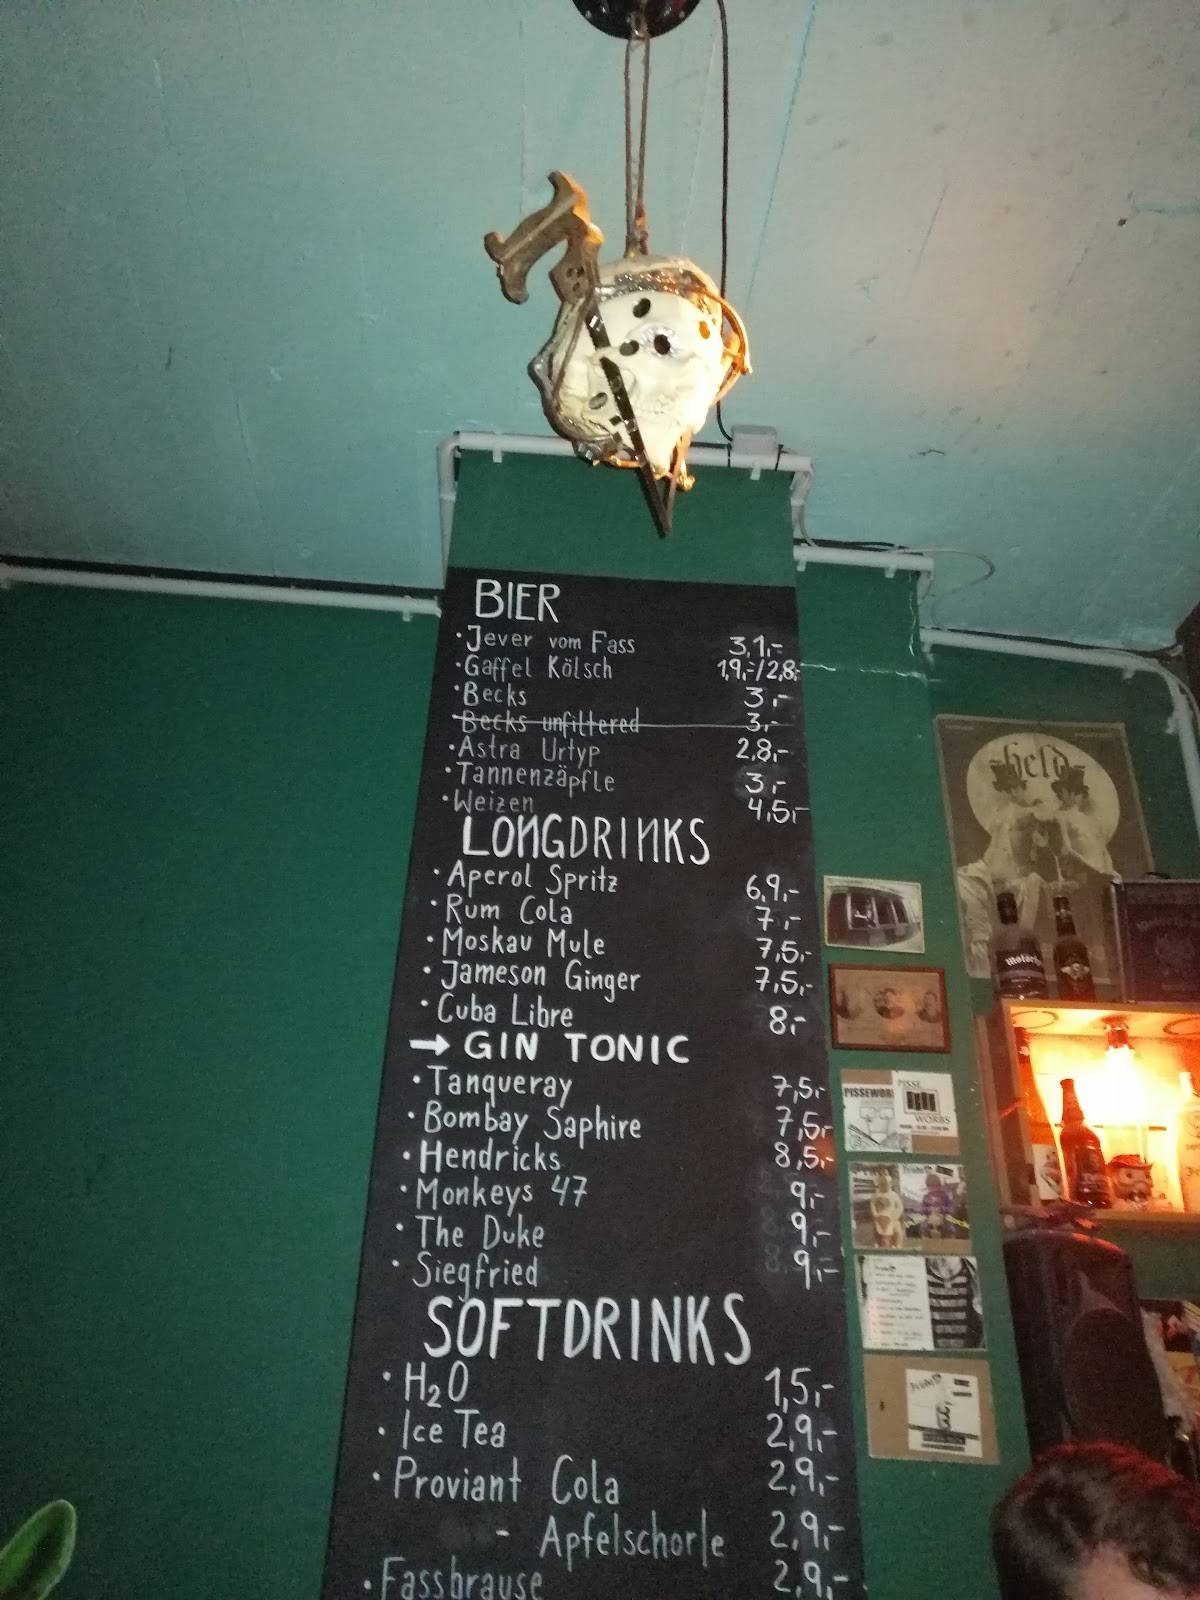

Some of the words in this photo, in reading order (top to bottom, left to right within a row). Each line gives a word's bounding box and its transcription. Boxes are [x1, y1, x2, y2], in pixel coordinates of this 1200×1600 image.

[475, 578, 560, 623] BIER
[465, 625, 533, 652] Jever
[549, 634, 582, 651] vom
[591, 630, 636, 655] Fass
[464, 654, 532, 679] Gaffel
[548, 656, 613, 680] Kölsch
[463, 682, 528, 707] Becks
[461, 710, 528, 734] Becks
[542, 707, 640, 738] unfiltered
[457, 739, 521, 761] Astra
[542, 738, 601, 770] Urtyp
[456, 762, 616, 799] Tannenzäpfle
[454, 789, 534, 814] Weizen
[461, 813, 711, 866] LONGDRINKS
[446, 859, 532, 898] Aperol
[546, 864, 619, 899] Spritz
[446, 894, 500, 925] Rum
[520, 895, 573, 925] Cola
[441, 927, 532, 959] Moskau
[547, 928, 606, 960] Mule
[441, 958, 547, 991] Jameson
[564, 959, 641, 1003] Ginger
[437, 993, 497, 1024] Cuba
[511, 994, 574, 1029] Libre
[463, 1031, 539, 1062] GIN
[564, 1032, 691, 1065] TONIC
[426, 1064, 573, 1108] Tanqueray
[424, 1101, 529, 1145] Bombay
[543, 1105, 642, 1149] Saphire
[419, 1139, 561, 1174] Hendricks
[416, 1176, 534, 1217] Monkeys
[550, 1175, 589, 1208] 47
[414, 1214, 464, 1249] The
[482, 1216, 546, 1251] Duke
[411, 1251, 538, 1301] Siegfried
[423, 1292, 752, 1366] SOFTDRINKS
[402, 1409, 444, 1450] Ice
[455, 1408, 506, 1449] Tea
[394, 1455, 522, 1502] Proviant
[551, 1454, 620, 1506] Cola
[538, 1508, 725, 1572] Apfelschorle
[380, 1555, 544, 1600] Fassbrause
